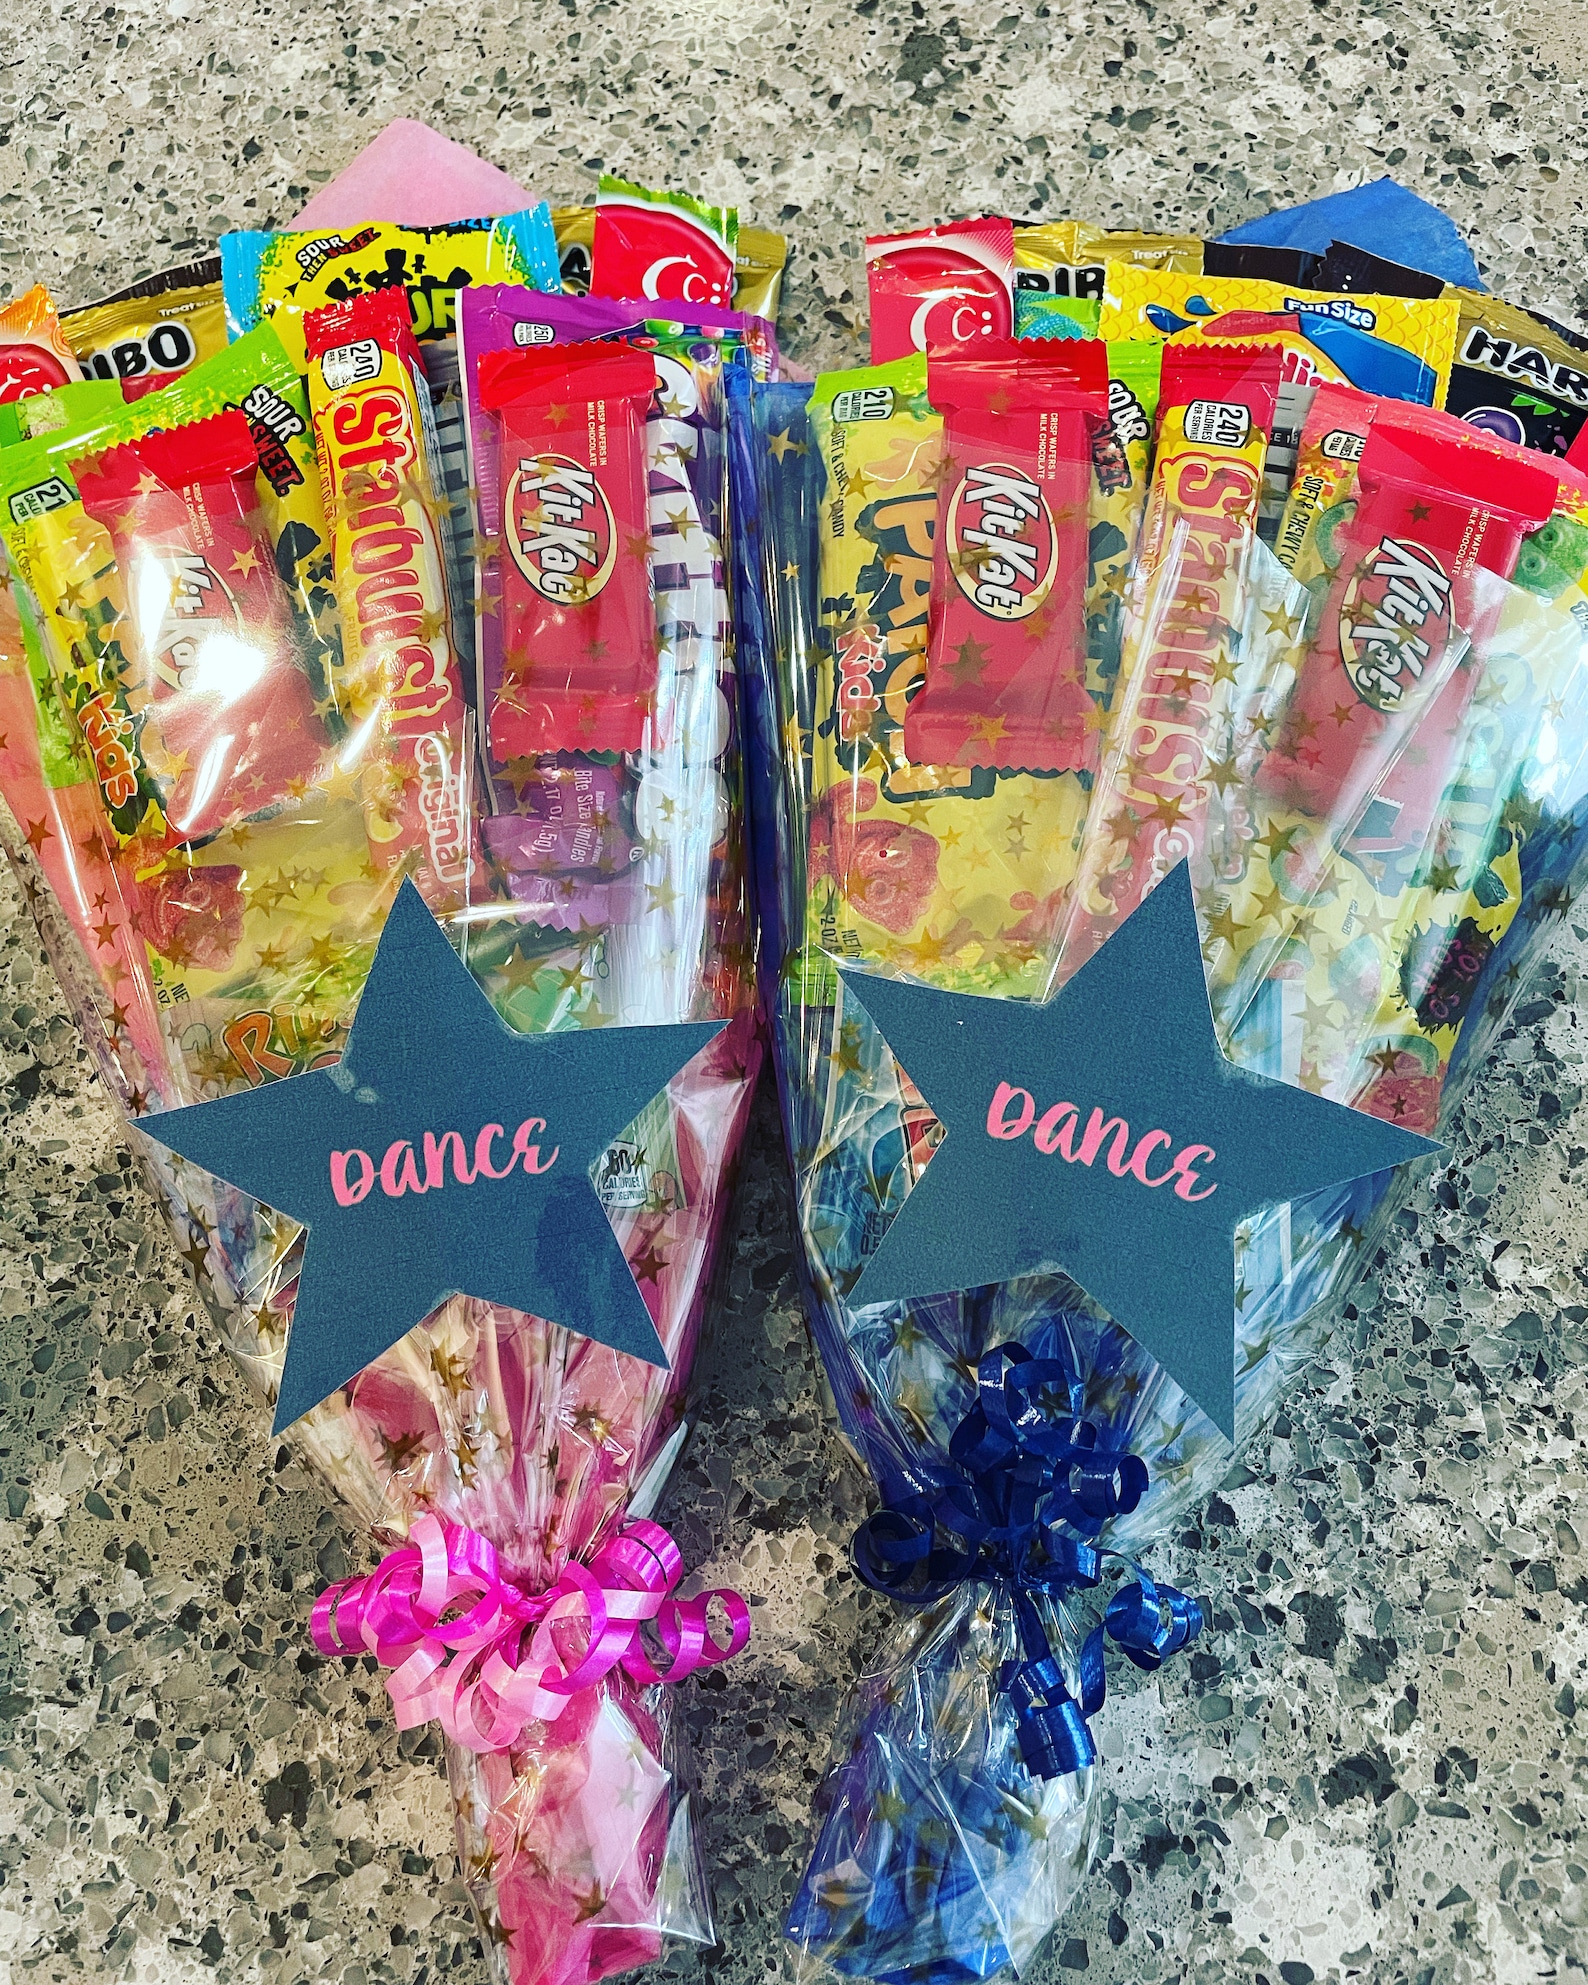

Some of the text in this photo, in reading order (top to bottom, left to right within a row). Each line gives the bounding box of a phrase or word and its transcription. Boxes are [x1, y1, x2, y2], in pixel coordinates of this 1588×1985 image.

[297, 236, 346, 267] SOUR
[302, 254, 328, 282] THEN
[1132, 249, 1167, 260] Treat
[158, 302, 196, 317] Treat
[1287, 301, 1374, 328] Fun Size
[534, 324, 549, 341] 250
[350, 343, 374, 379] 240
[245, 386, 303, 442] SOUR
[597, 400, 606, 422] CRISP
[840, 396, 849, 406] PER
[850, 391, 862, 419] CALORIES
[863, 389, 888, 418] 210
[587, 402, 598, 467] MILK CHOCOLATE
[1189, 402, 1204, 440] PER SERVING
[1200, 404, 1217, 441] CALORIES
[1215, 406, 1244, 445] 240
[598, 423, 607, 460] WAFERS
[831, 430, 846, 453] SOFT
[832, 453, 844, 464] &
[1037, 413, 1048, 480] MILK CHOCOLATE
[1047, 412, 1059, 480] CRISP WAFERS IN
[1299, 475, 1325, 503] SOFT
[1302, 501, 1314, 511] &
[186, 502, 206, 550] CHOCOLATE
[197, 503, 212, 537] WAFERS
[208, 536, 216, 547] IN
[832, 500, 845, 539] CANDY
[1281, 511, 1312, 555] CHEWY
[334, 395, 449, 713] Starburst
[1451, 507, 1480, 576] MILK CHOCOLATE
[1465, 509, 1491, 579] CRISP WAFERS IN
[346, 616, 359, 649] FRUIT
[1126, 463, 1255, 808] Starburst
[836, 623, 887, 742] Kids
[77, 691, 140, 810] Kids
[574, 769, 592, 791] Bite
[415, 731, 476, 883] Original
[576, 793, 594, 820] Size
[601, 1192, 614, 1201] PER
[602, 1176, 641, 1190] CALORIES
